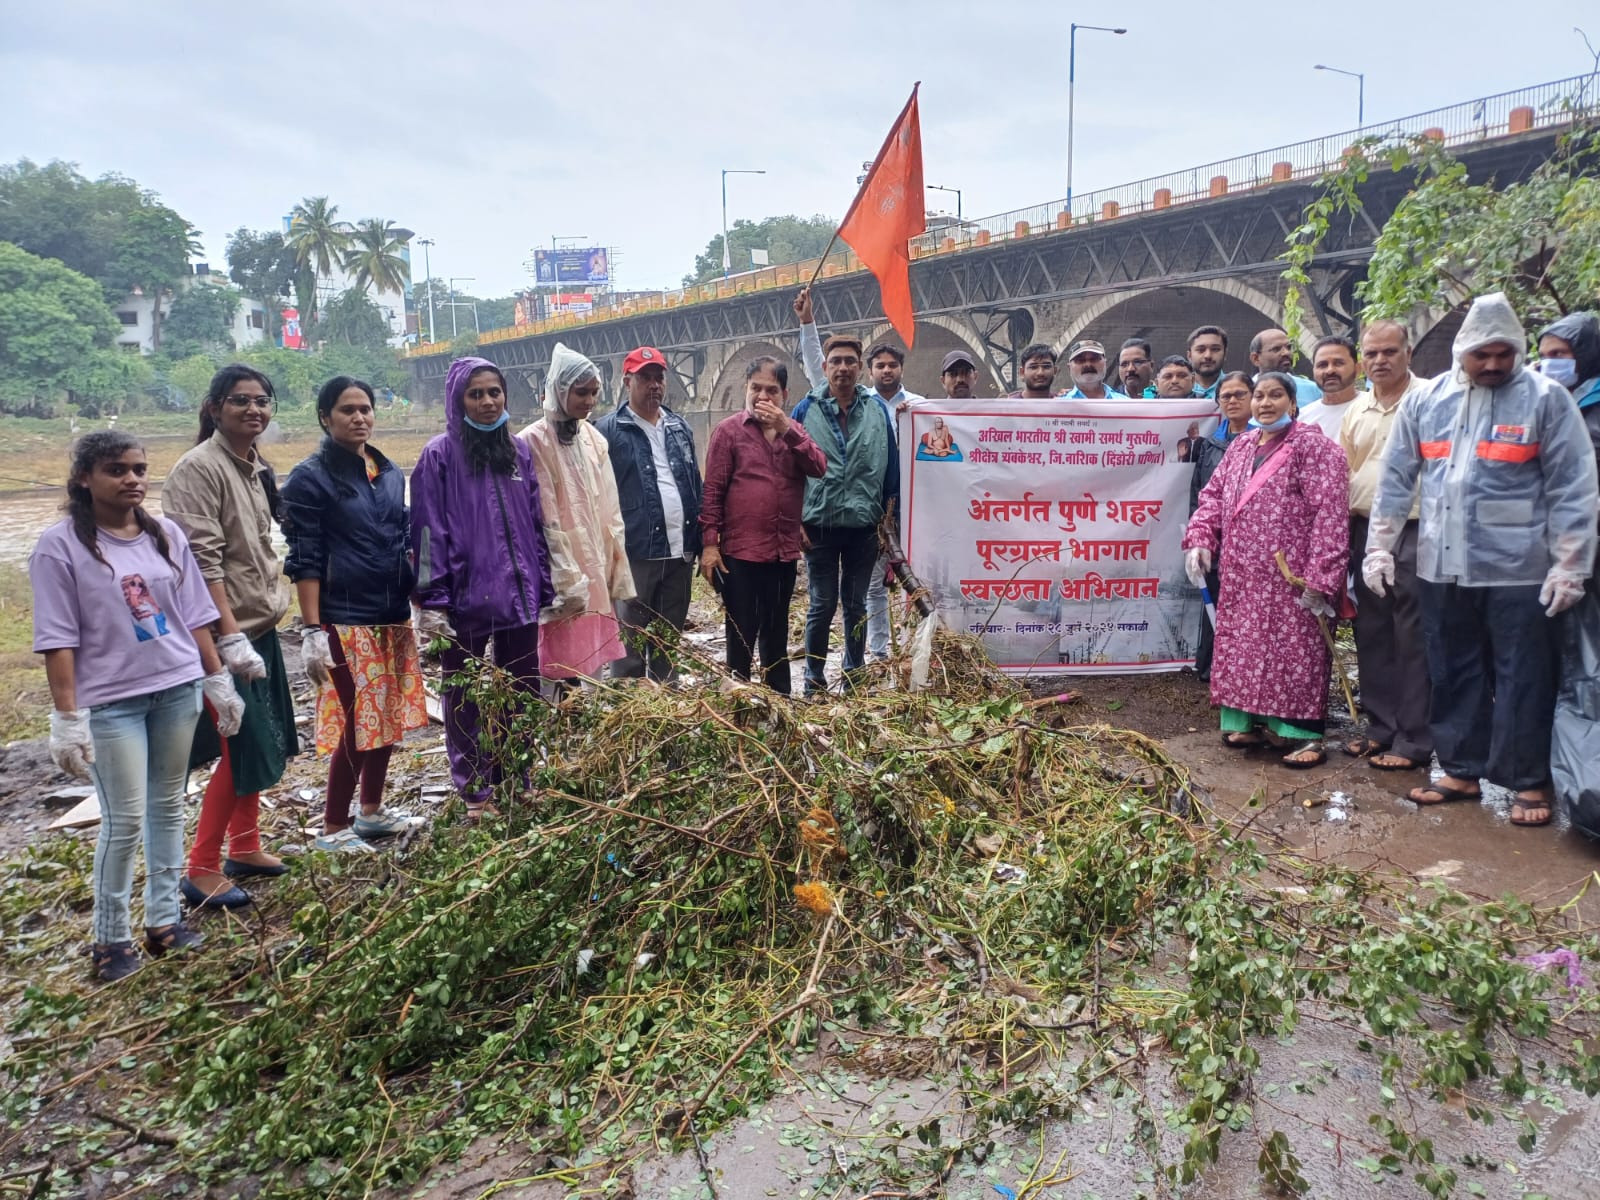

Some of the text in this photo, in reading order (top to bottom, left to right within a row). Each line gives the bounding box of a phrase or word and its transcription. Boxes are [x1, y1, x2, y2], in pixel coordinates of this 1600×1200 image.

[978, 427, 1013, 443] अखिल
[1015, 428, 1051, 443] भारतीय
[1054, 428, 1067, 444] श्री
[1069, 429, 1096, 444] स्वामी
[1098, 429, 1124, 445] समर्थ
[969, 447, 999, 464] श्रीक्षेत्र
[967, 491, 1163, 532] अंतर्गत पुणे शहर
[976, 538, 1150, 571] पूरग्रस्त भागात
[959, 571, 1160, 601] स्वच्छता अभियान
